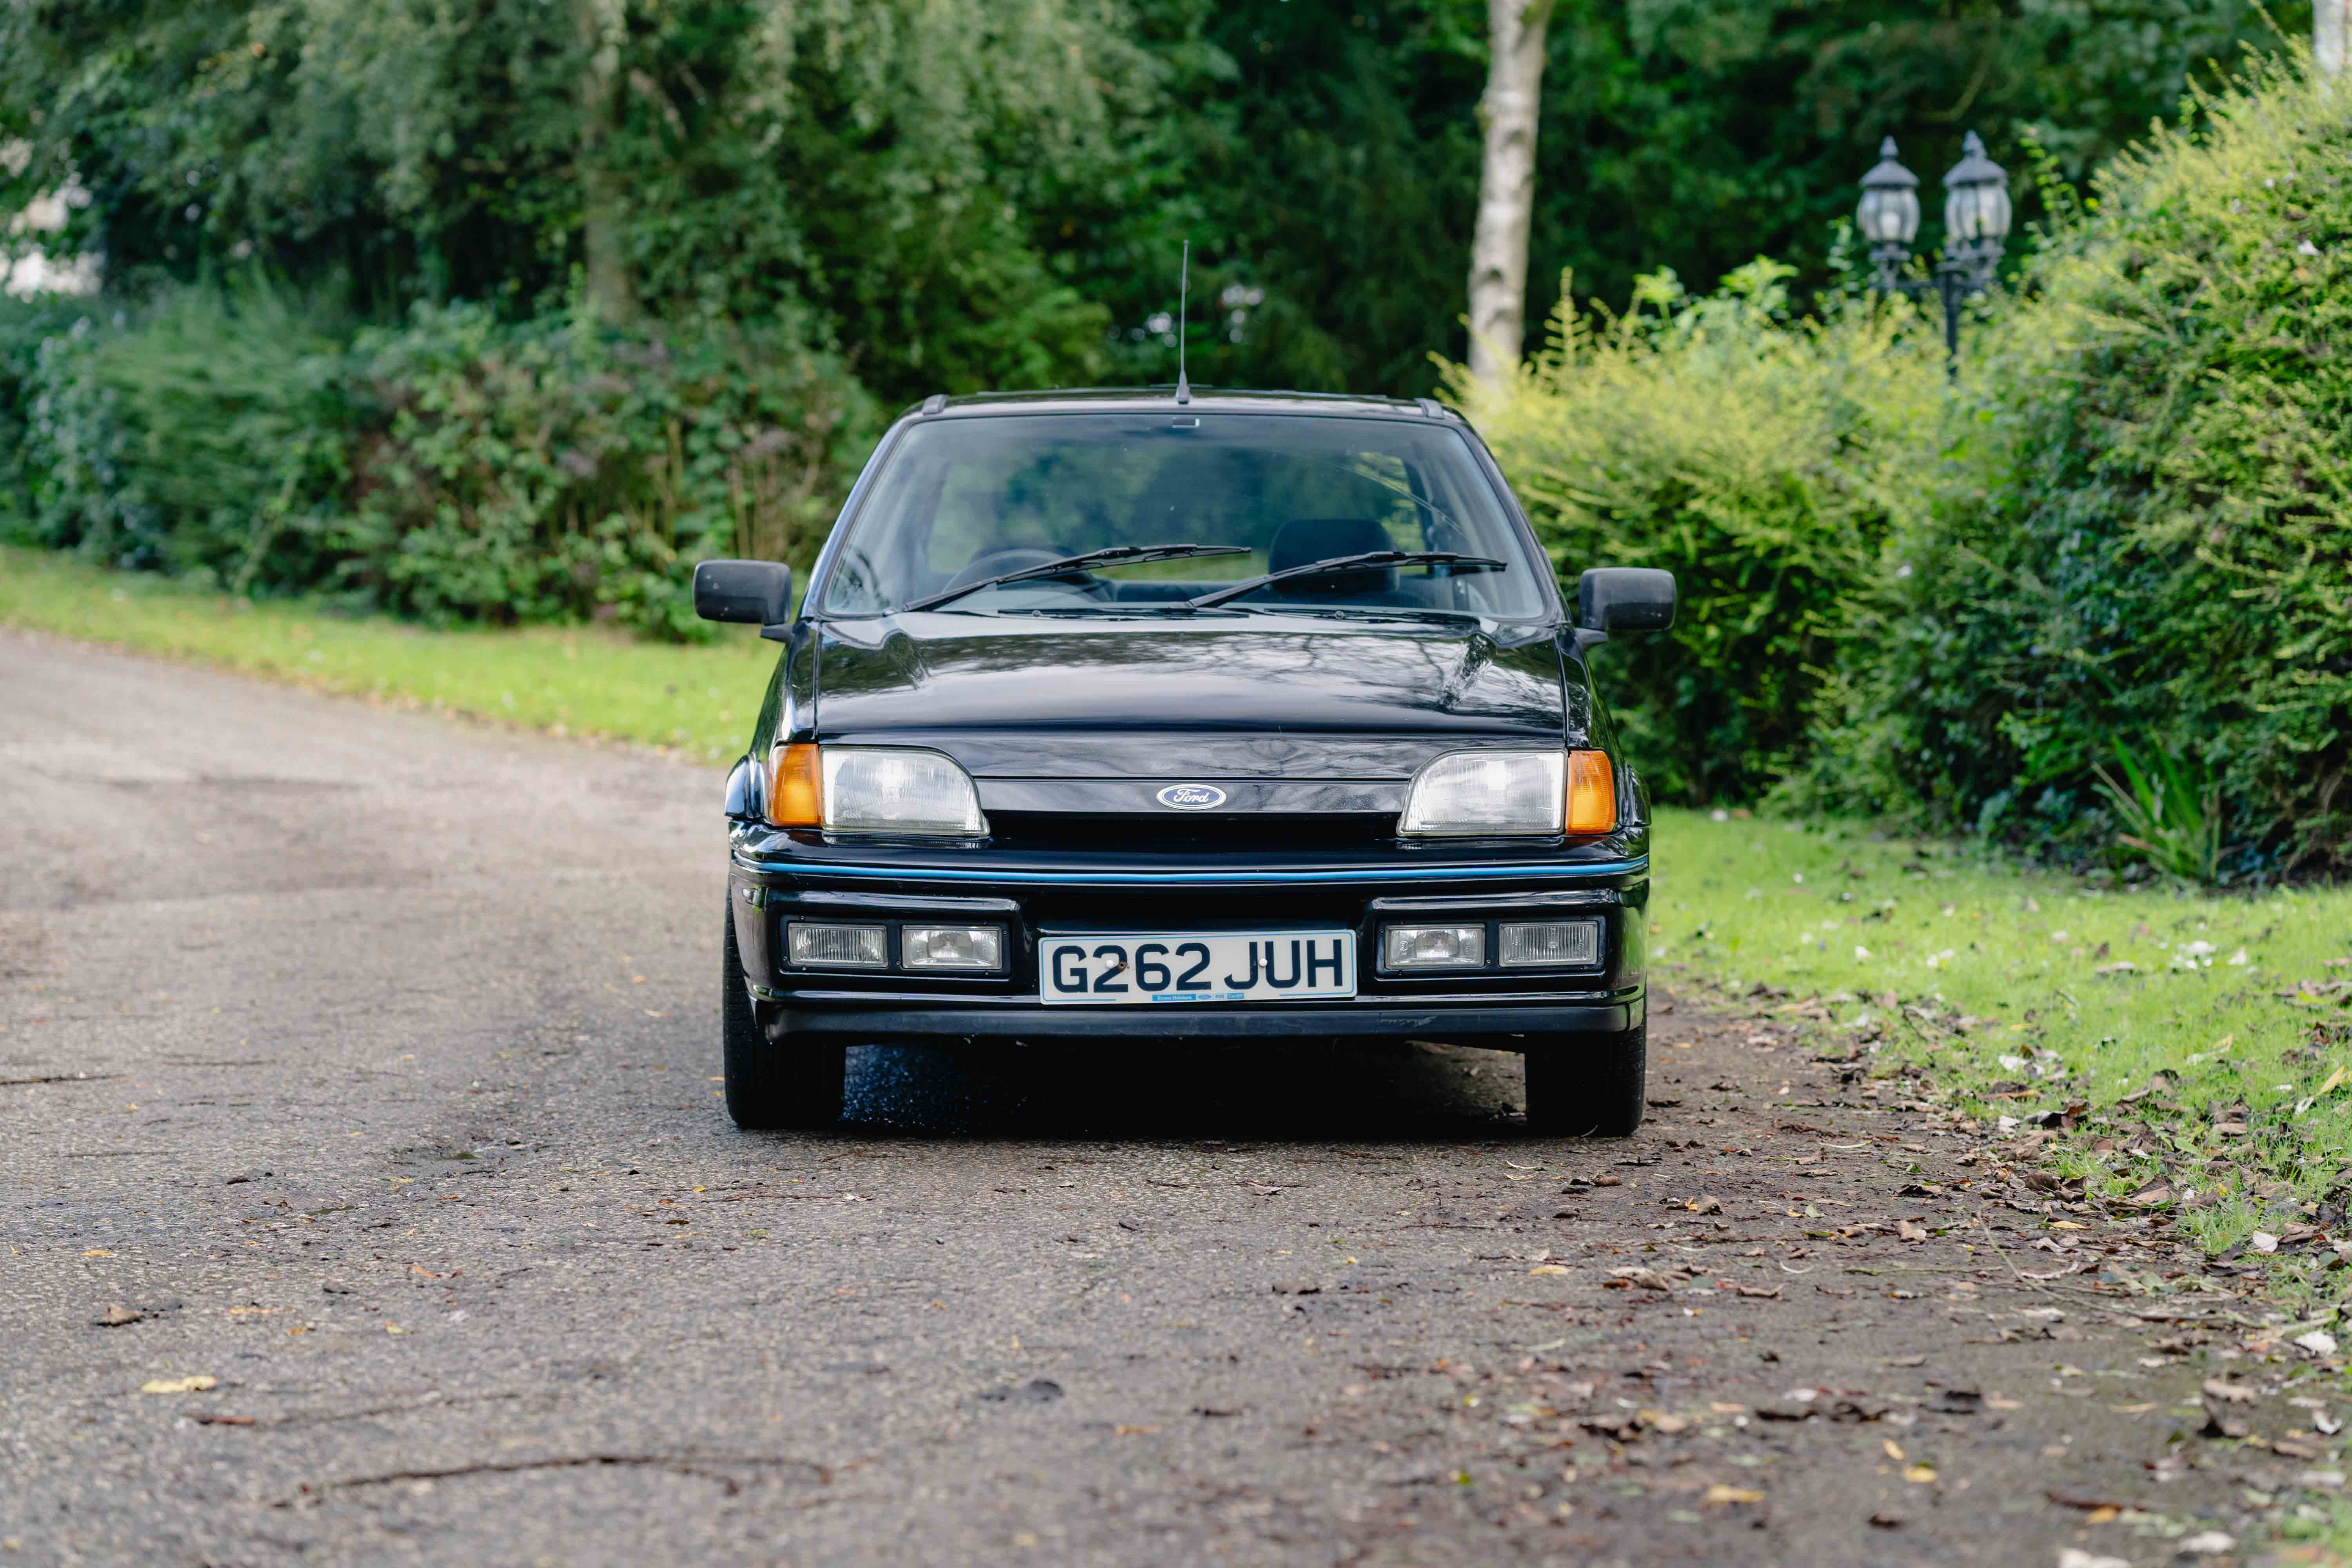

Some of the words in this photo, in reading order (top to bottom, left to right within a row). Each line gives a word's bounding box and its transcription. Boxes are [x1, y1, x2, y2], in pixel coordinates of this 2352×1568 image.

[1173, 789, 1209, 803] Ford
[1052, 943, 1211, 993] G262
[1224, 939, 1343, 990] JUH
